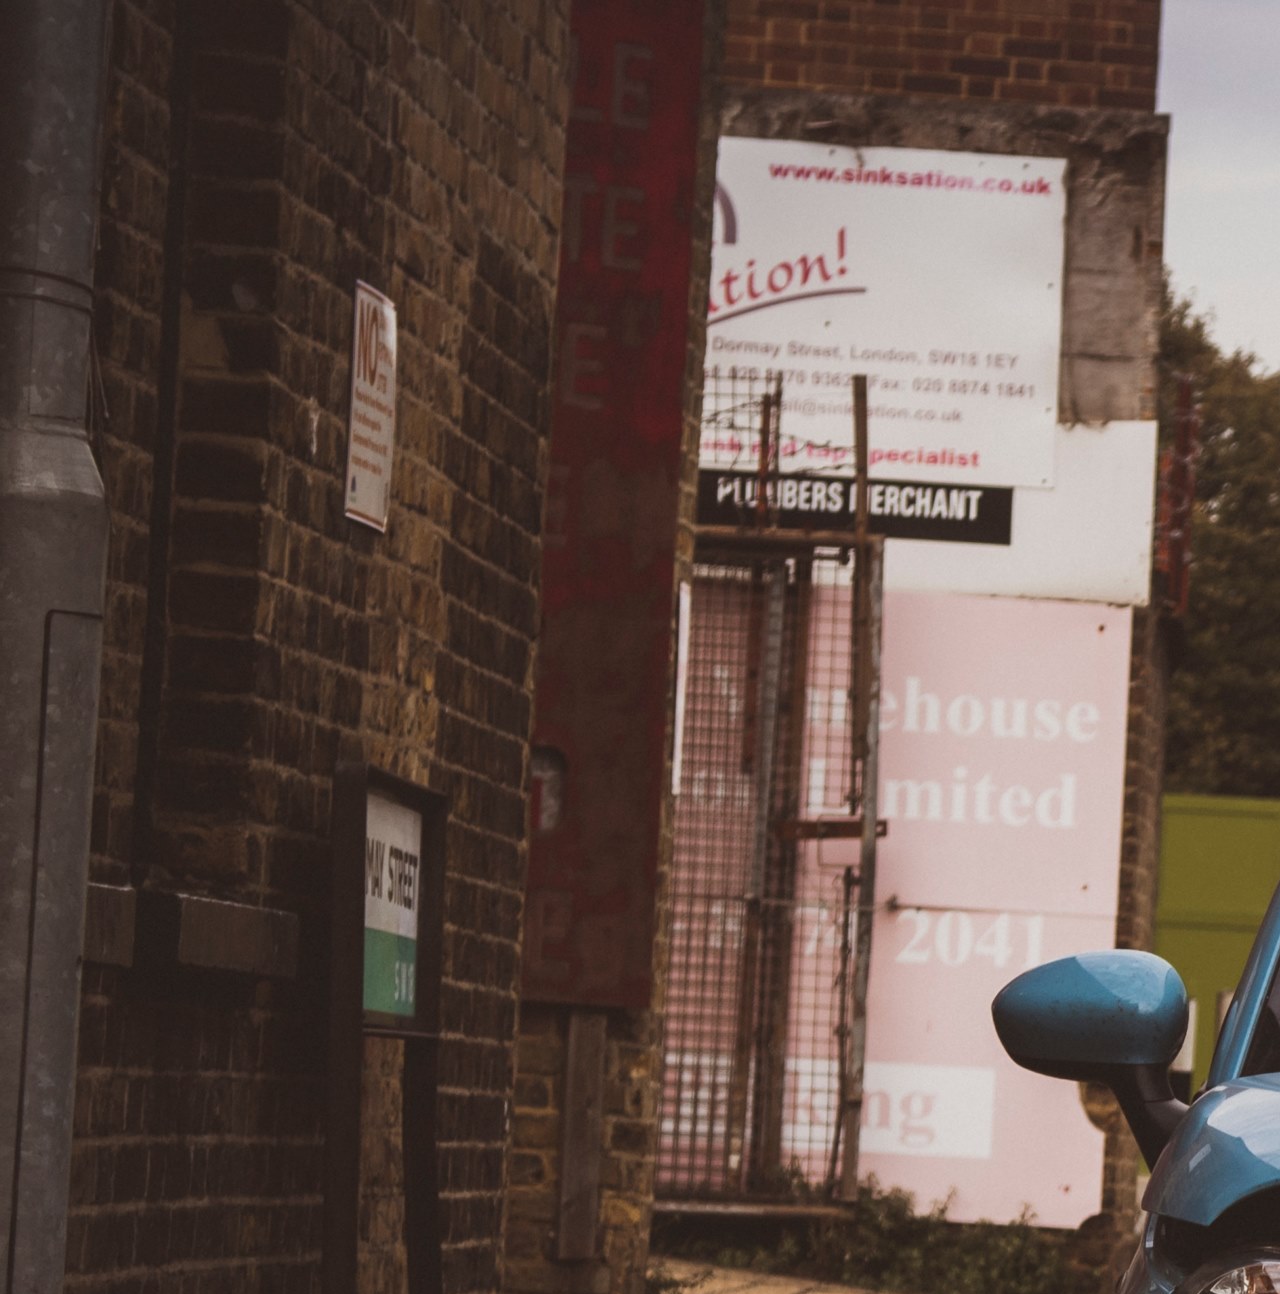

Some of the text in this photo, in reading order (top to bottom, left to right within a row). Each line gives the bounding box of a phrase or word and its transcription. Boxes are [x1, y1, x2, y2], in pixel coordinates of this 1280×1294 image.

[769, 163, 1052, 196] www.sinksation.co.uk
[708, 226, 848, 313] tion!
[712, 335, 781, 358] Dormay
[850, 345, 922, 366] London,
[868, 446, 980, 467] pecialist
[388, 845, 418, 910] STREET
[895, 908, 1046, 968] 2041
